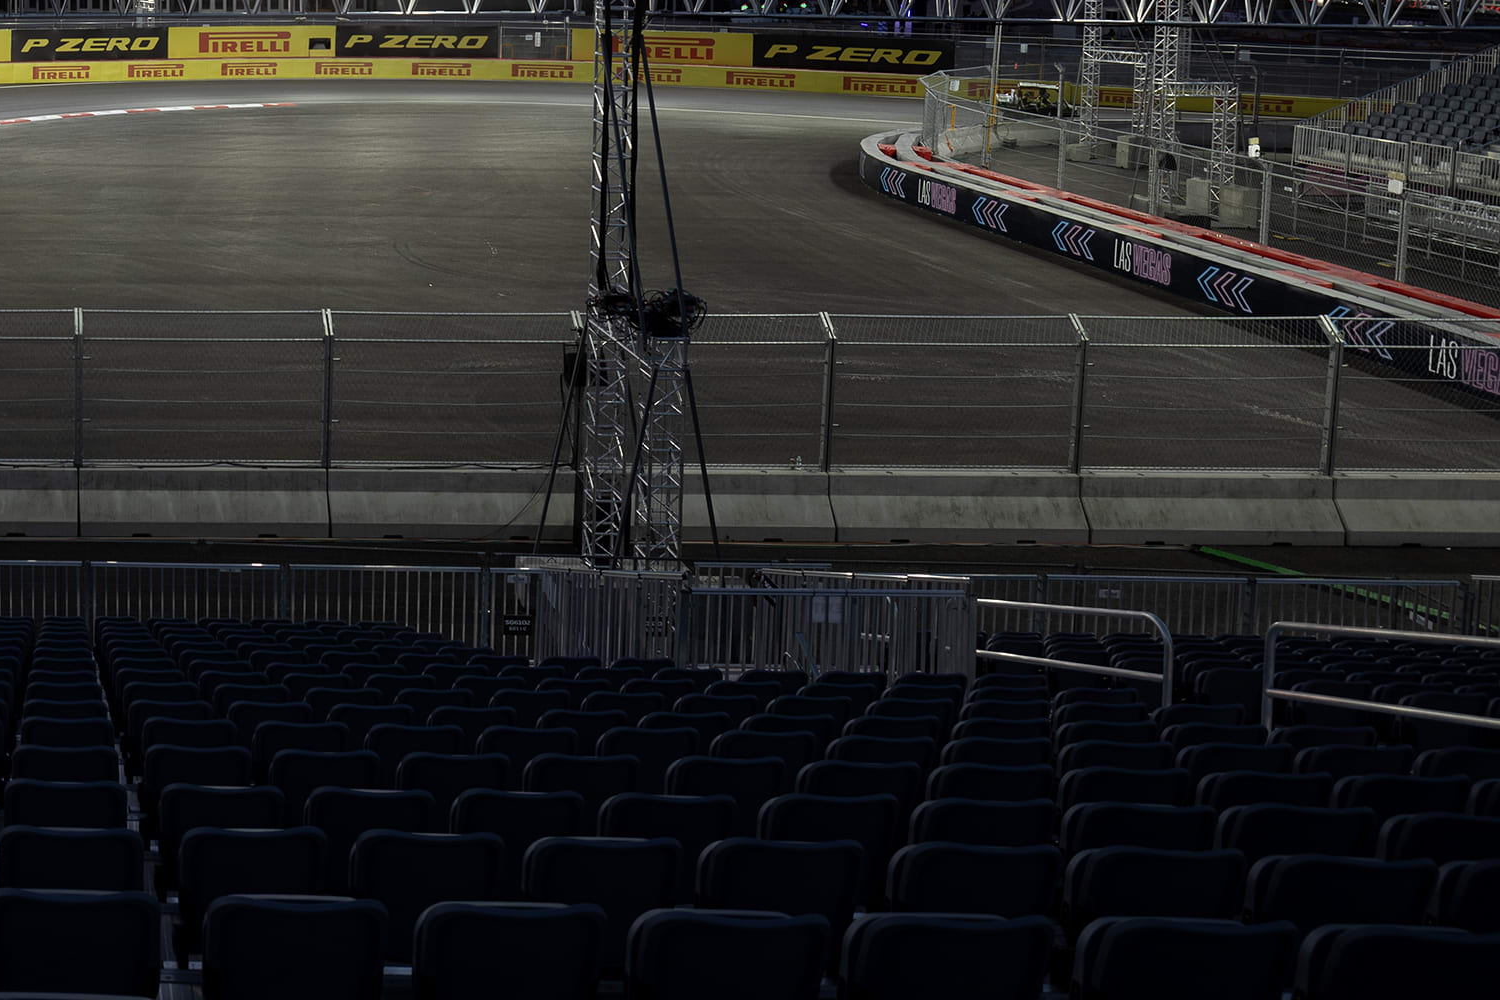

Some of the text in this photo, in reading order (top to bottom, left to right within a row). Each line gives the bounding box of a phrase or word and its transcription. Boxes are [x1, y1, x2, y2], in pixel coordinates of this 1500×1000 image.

[21, 36, 160, 52] P ZERO
[199, 31, 291, 53] PIRELLI
[344, 34, 489, 49] P ZERO
[611, 36, 715, 60] PRELLI
[764, 44, 943, 66] P ZERO
[33, 65, 90, 79] PIRELLI
[128, 63, 184, 77] PIRELLI
[221, 62, 277, 76] PIRELLI
[315, 61, 373, 75] PIRELLI
[412, 62, 471, 76] PIRELLI
[512, 63, 574, 79] PIRELLI
[616, 67, 682, 82] PRELLI
[726, 71, 796, 88] PIRELLI
[843, 76, 918, 94] PIRELLI
[917, 178, 931, 207] LAS
[1114, 238, 1172, 286] LAS VEGAS
[1428, 334, 1500, 395] LAS VEG
